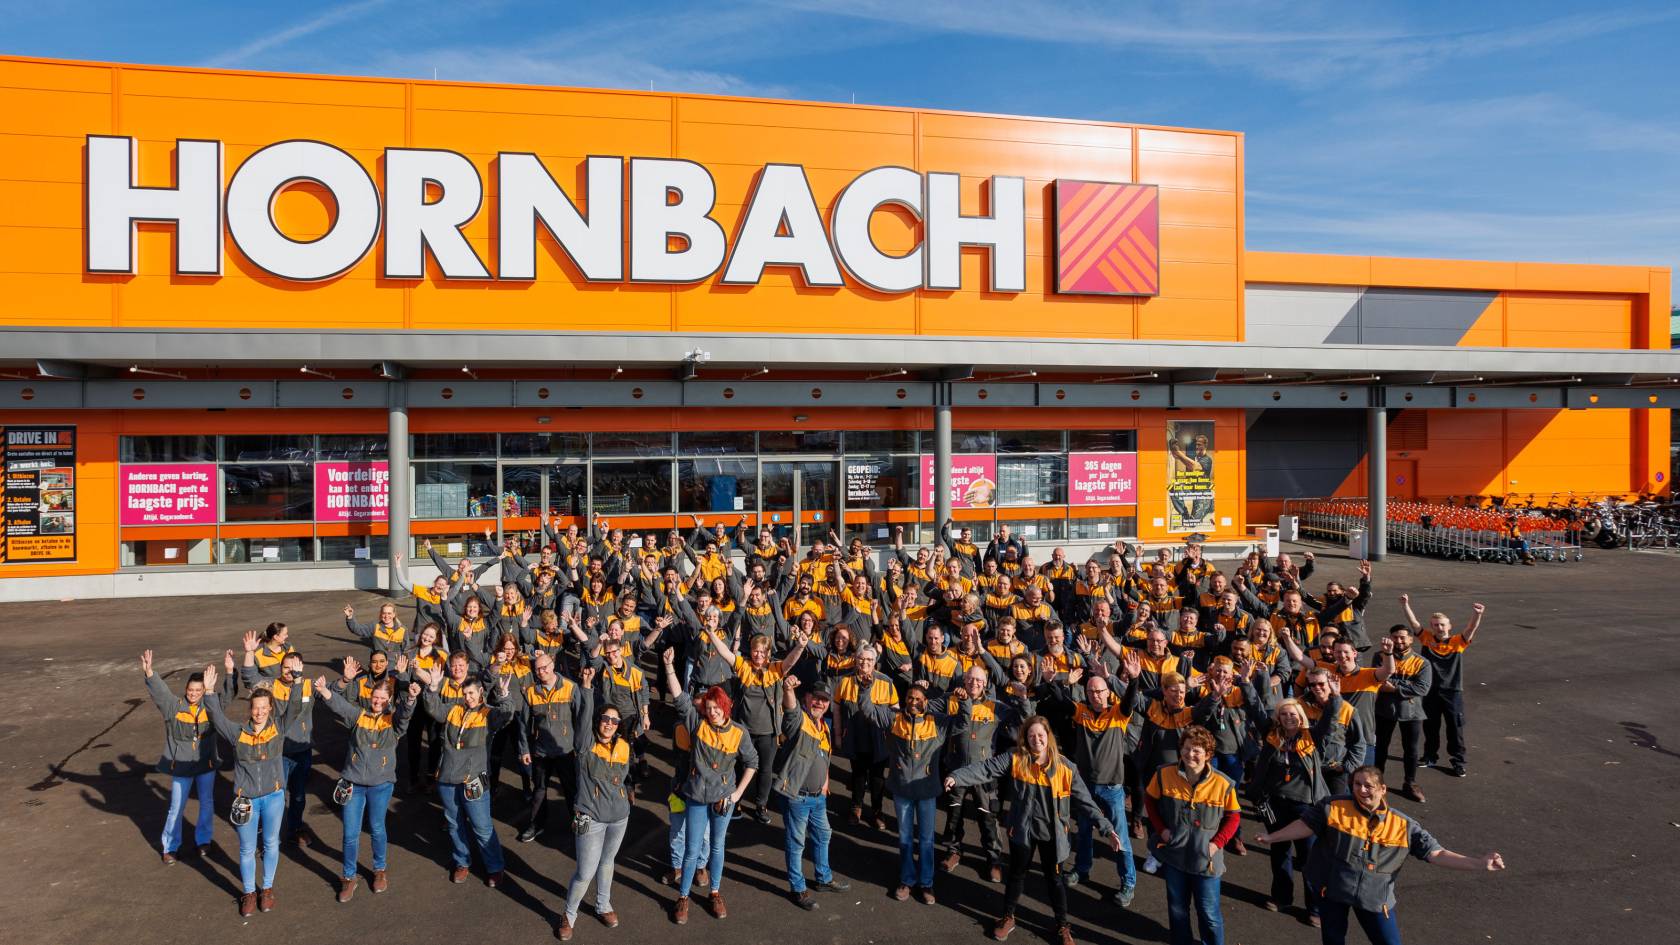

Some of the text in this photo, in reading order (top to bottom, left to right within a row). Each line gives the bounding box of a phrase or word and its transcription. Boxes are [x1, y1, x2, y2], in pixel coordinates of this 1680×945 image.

[86, 134, 1026, 293] HORNBACH
[9, 431, 57, 445] DRIVE IN
[848, 465, 881, 474] GEOPEND:
[1084, 461, 1122, 472] 365 dagen
[128, 471, 209, 482] Anderen geven korting,
[327, 468, 389, 484] Voordelige
[1099, 472, 1109, 480] jaar
[128, 483, 209, 495] HORNBACH geeft de
[328, 484, 343, 493] kan
[345, 483, 358, 493] het
[360, 483, 382, 493] enkel
[1075, 479, 1132, 493] laagste prijs!
[128, 495, 209, 511] laagste prijs.
[327, 494, 389, 508] HORNBACH
